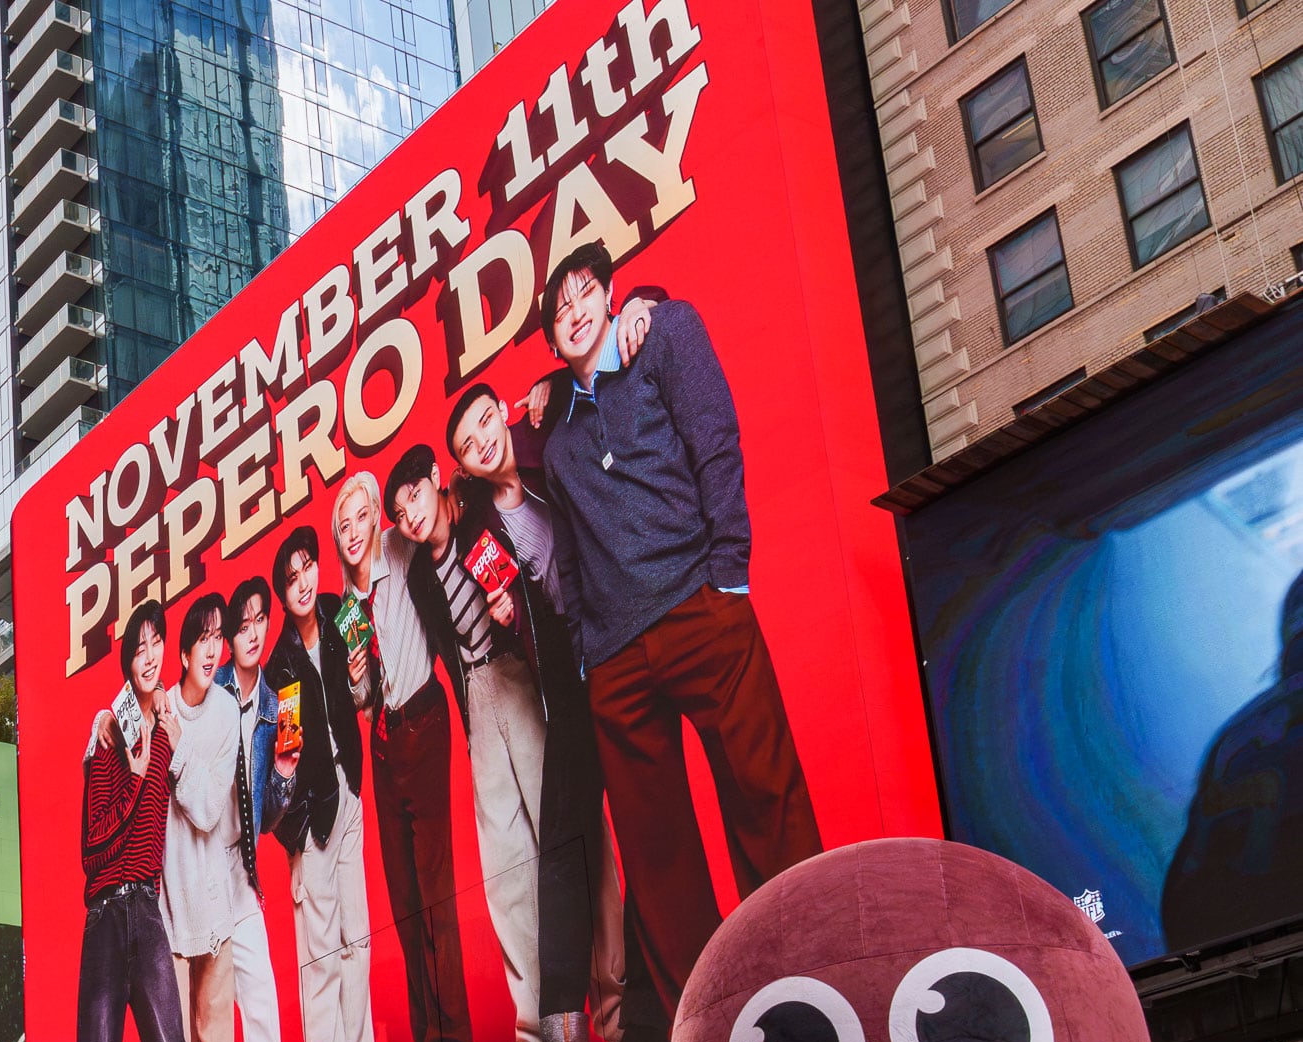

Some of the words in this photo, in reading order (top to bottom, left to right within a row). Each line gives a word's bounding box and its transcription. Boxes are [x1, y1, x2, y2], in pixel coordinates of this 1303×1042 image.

[65, 167, 471, 565] NOVEMBER
[495, 0, 702, 201] 11th
[65, 317, 425, 679] PEPERO
[449, 61, 710, 379] DAY
[472, 540, 497, 581] PEPERO
